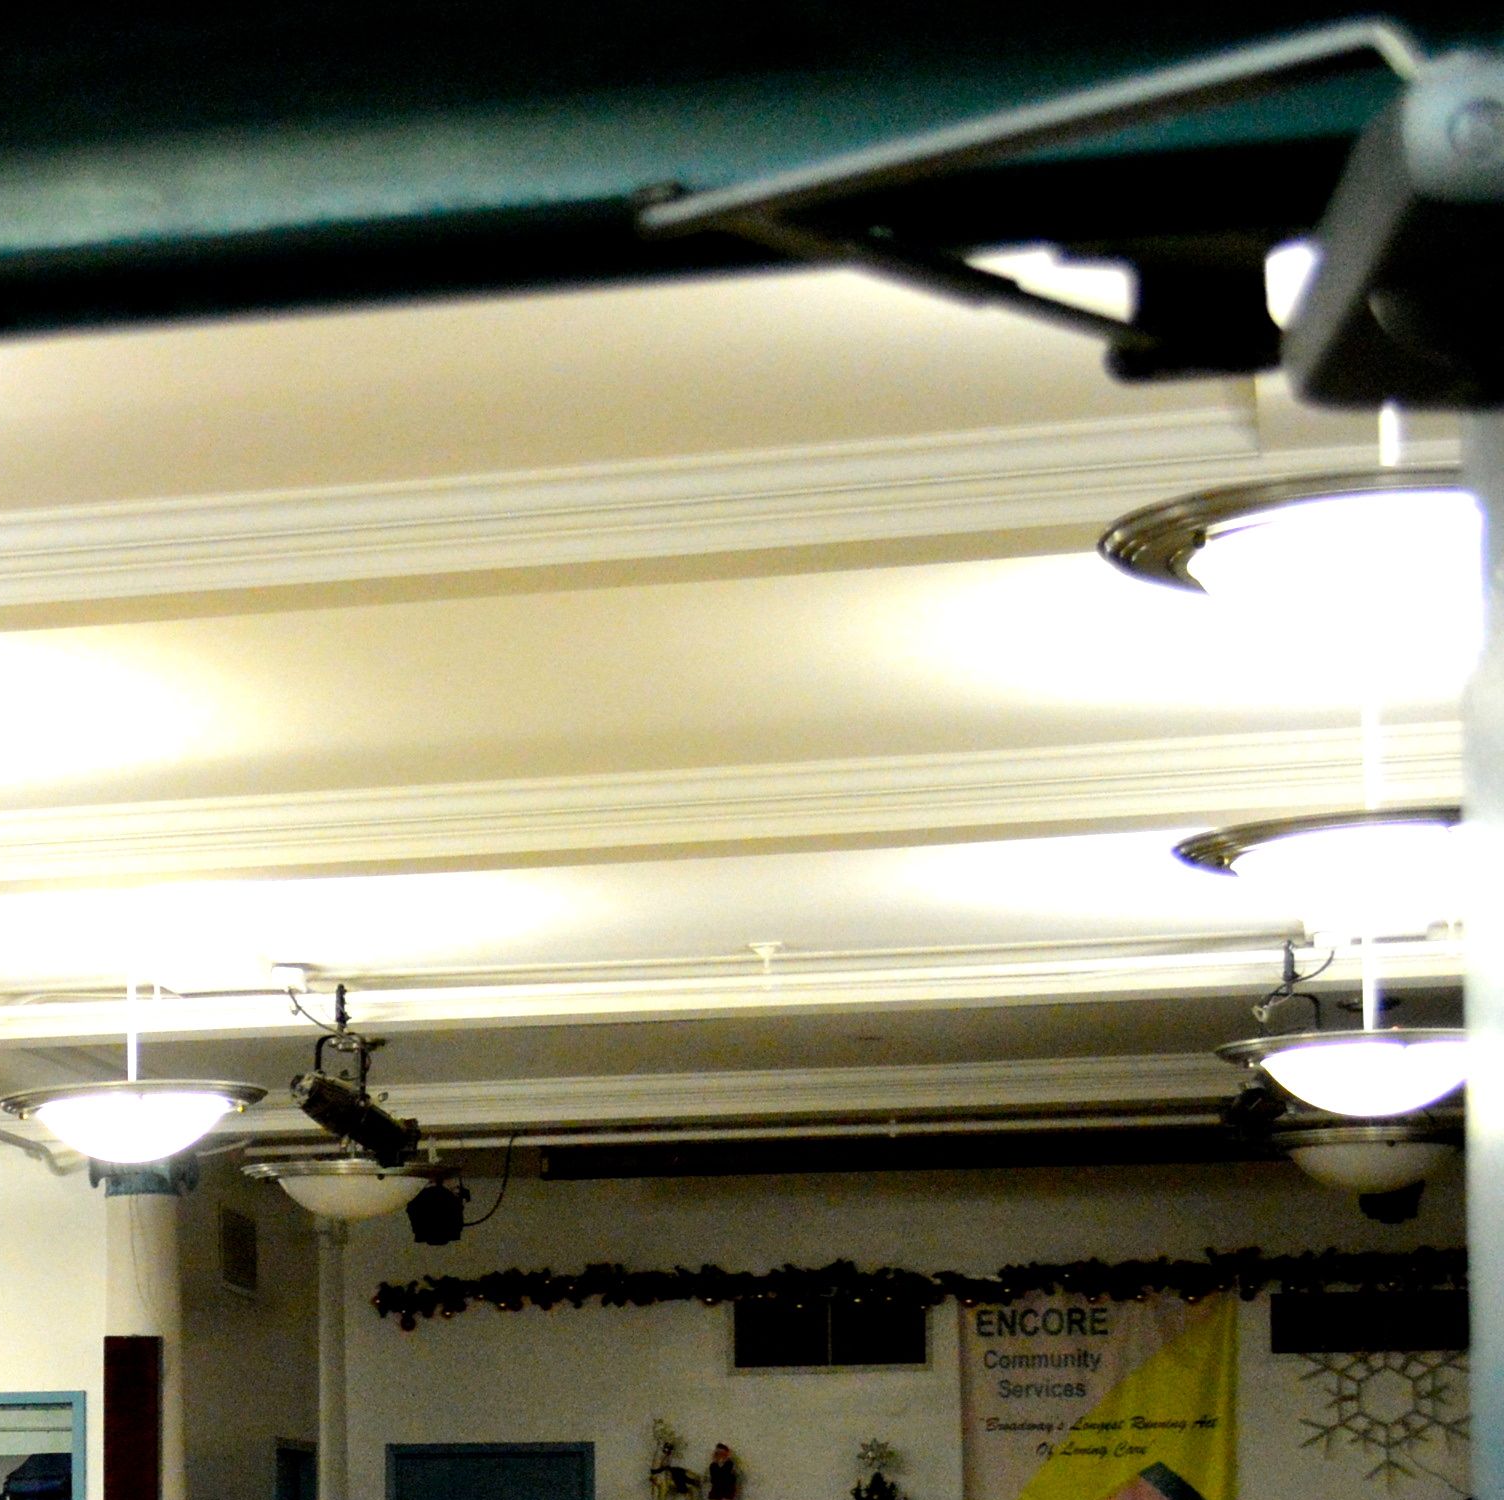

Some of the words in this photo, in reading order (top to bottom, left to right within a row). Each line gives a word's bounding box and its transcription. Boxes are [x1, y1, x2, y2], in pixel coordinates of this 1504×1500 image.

[975, 1308, 1109, 1337] ENCORE
[983, 1349, 1103, 1373] Community
[997, 1378, 1087, 1400] Services
[1130, 1415, 1187, 1434] Running
